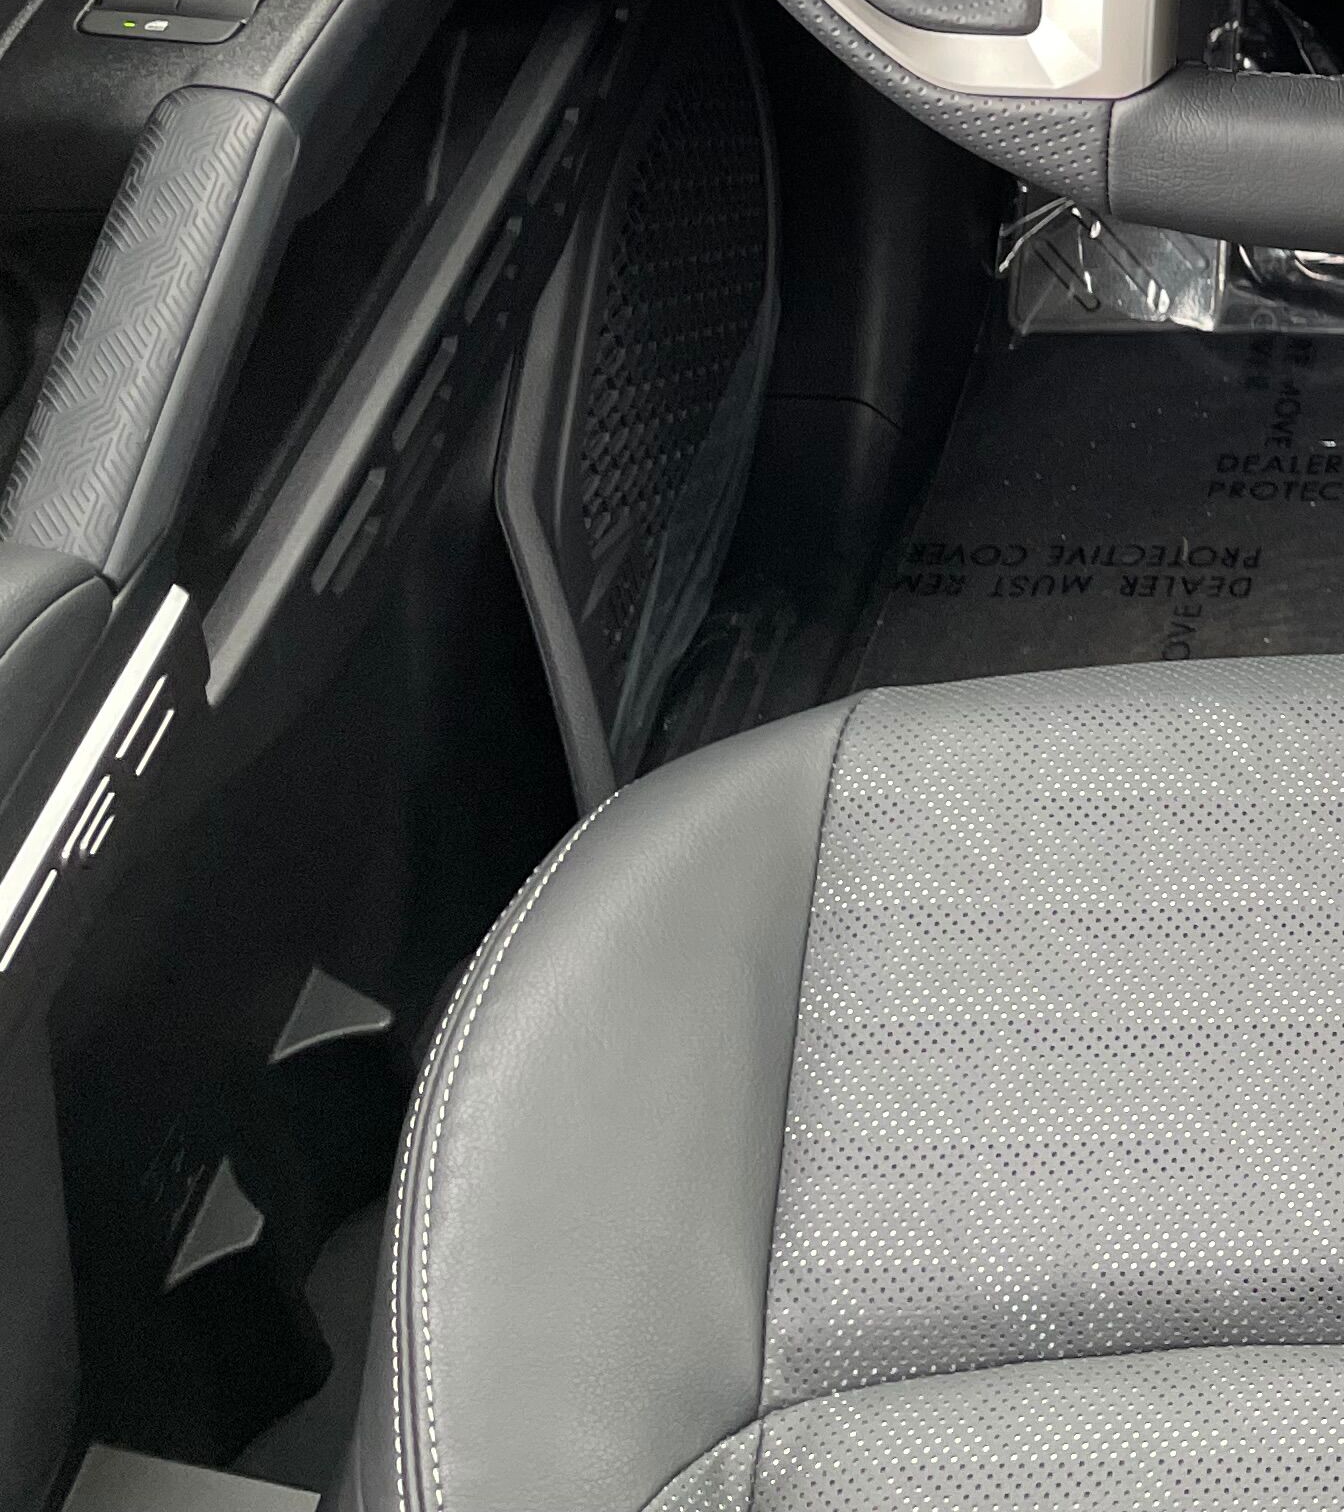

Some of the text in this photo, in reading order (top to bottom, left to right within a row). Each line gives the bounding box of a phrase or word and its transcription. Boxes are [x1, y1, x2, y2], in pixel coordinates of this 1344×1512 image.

[1215, 453, 1344, 476] DEALER
[905, 542, 1262, 569] PROTECTIVE COVER
[986, 573, 1254, 599] DEALER MUST
